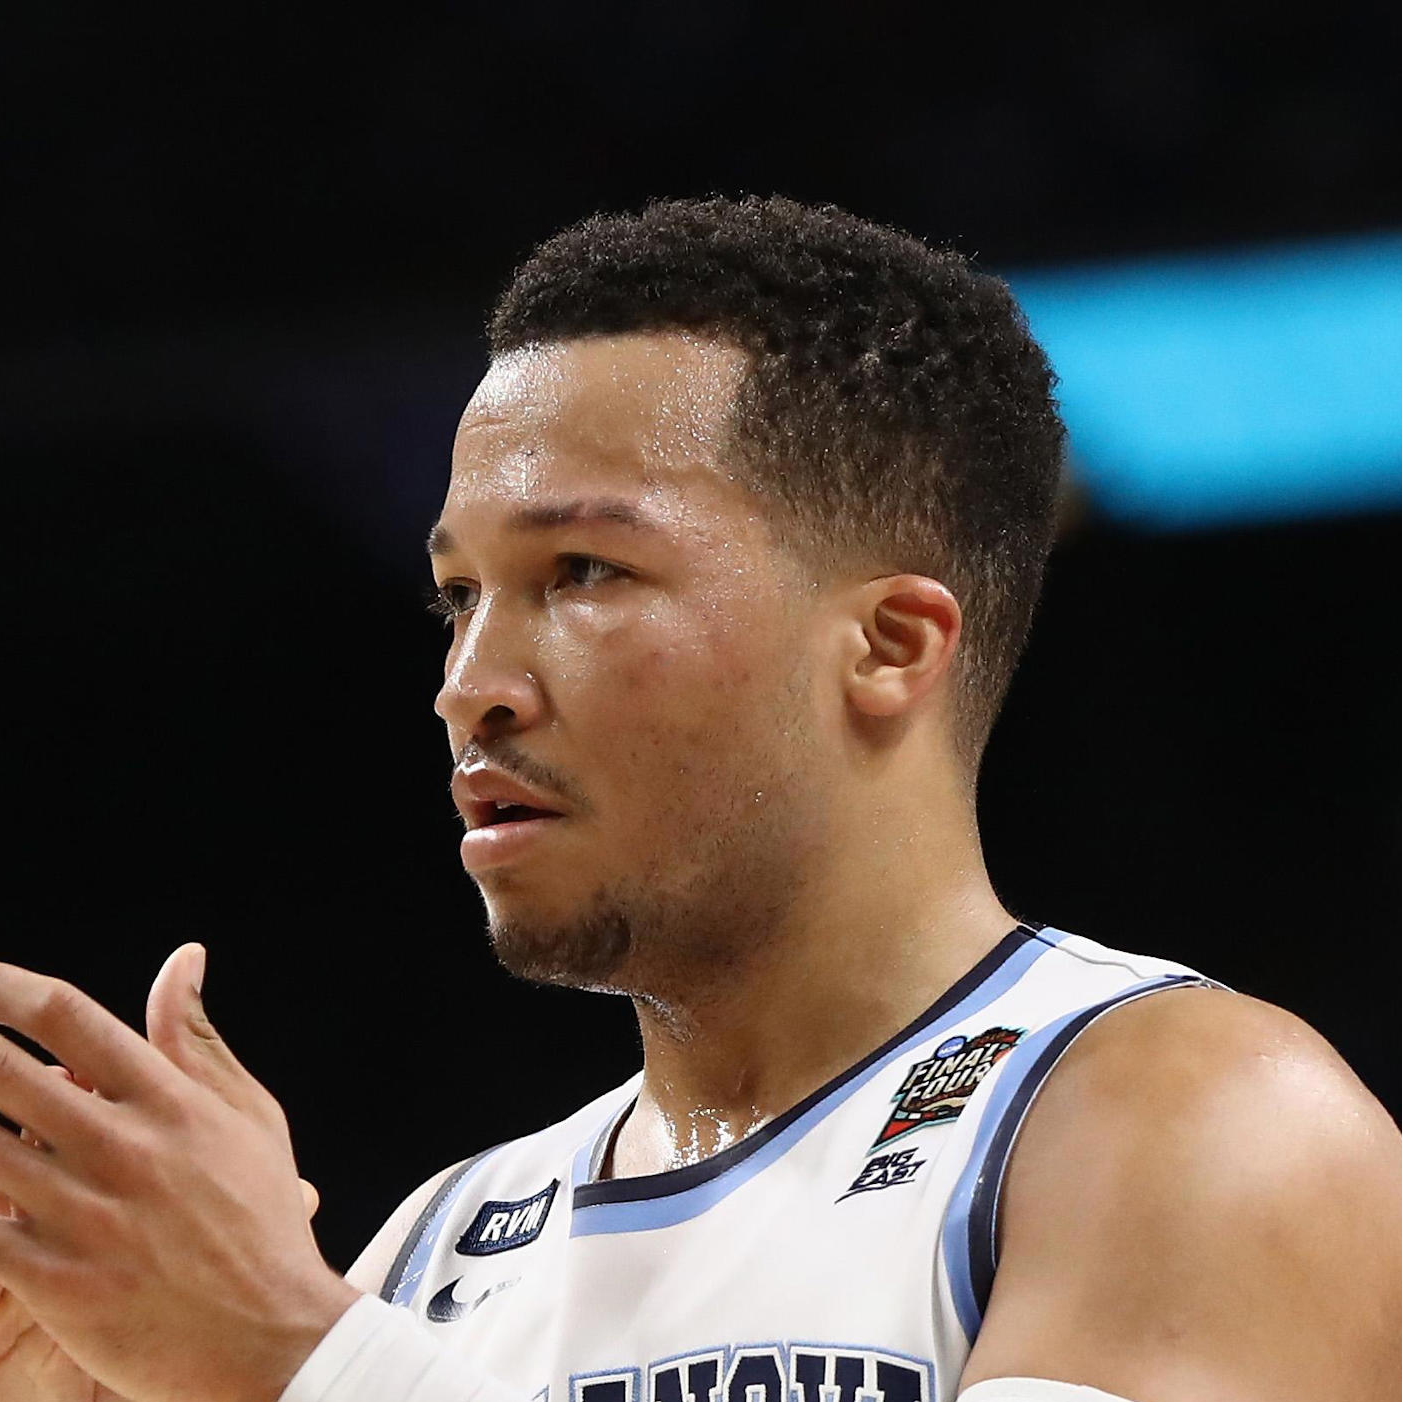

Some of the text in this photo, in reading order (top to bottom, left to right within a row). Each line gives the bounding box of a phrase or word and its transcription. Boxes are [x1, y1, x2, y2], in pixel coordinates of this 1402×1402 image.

[902, 1043, 1000, 1091] FINAL
[902, 1062, 992, 1108] FOUR
[845, 1158, 929, 1193] EAST
[860, 1146, 920, 1176] BIG
[478, 1195, 548, 1242] RVM
